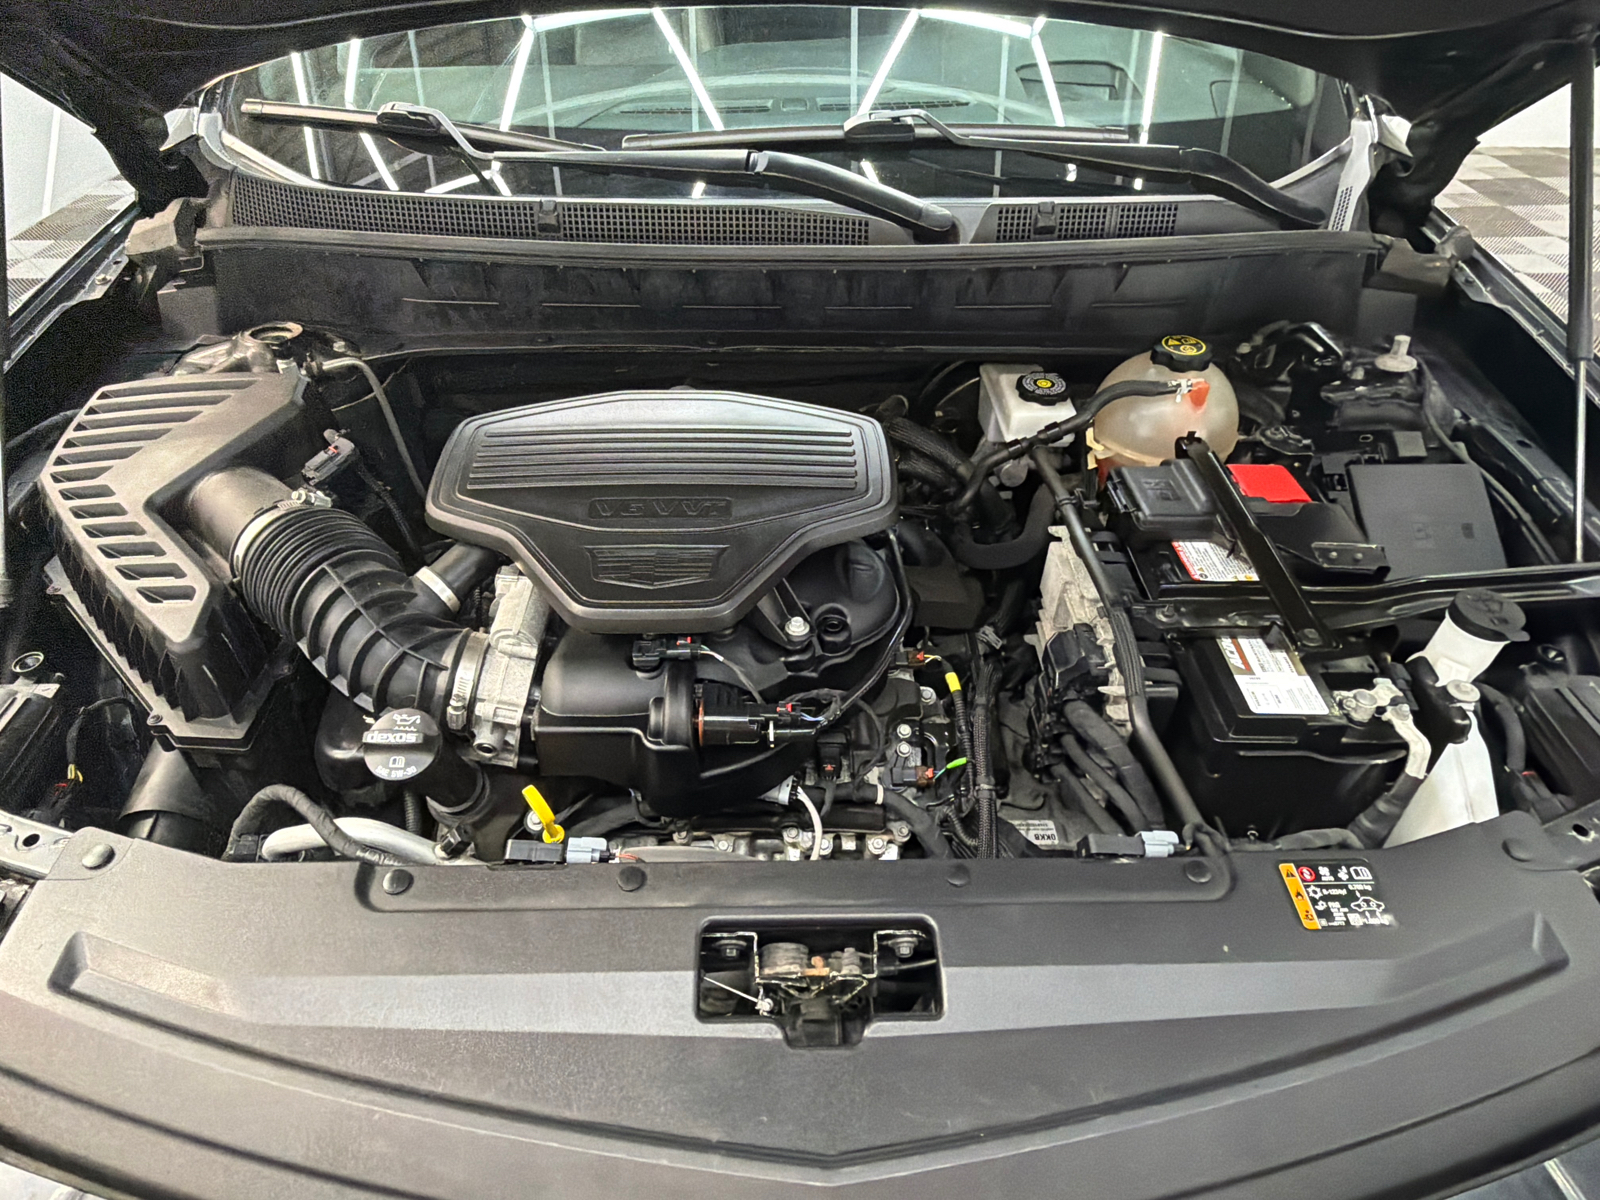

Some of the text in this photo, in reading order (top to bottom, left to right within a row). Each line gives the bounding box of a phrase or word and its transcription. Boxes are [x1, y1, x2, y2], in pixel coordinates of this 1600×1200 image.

[366, 731, 418, 743] dexos
[375, 765, 418, 778] SAE 5W-30
